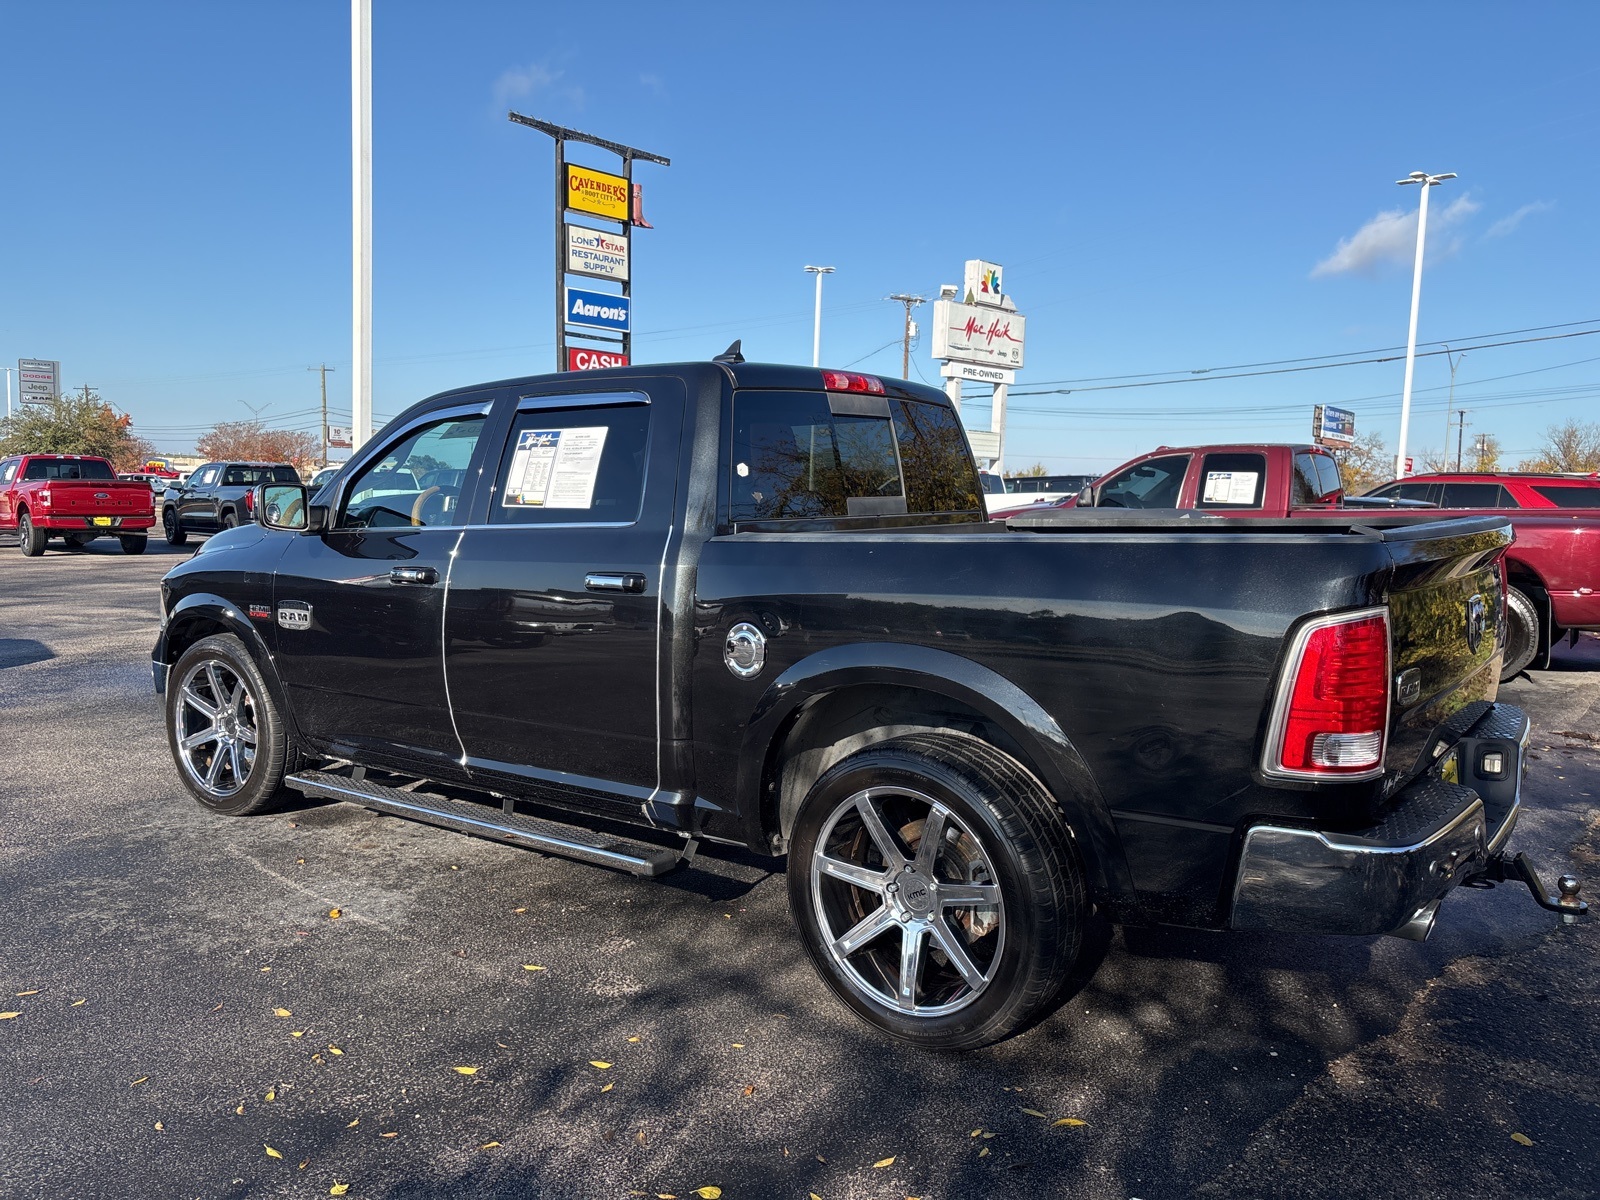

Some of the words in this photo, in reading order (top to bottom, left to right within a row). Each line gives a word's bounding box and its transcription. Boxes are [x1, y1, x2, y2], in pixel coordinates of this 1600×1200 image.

[569, 175, 627, 203] CAVENDER'S
[584, 189, 599, 199] BOOT
[600, 193, 615, 202] CITY
[571, 235, 595, 247] LONE
[604, 242, 625, 254] STAR
[571, 248, 626, 267] RESTAURANT
[583, 261, 615, 274] SUPPLY
[571, 298, 627, 322] Aaron's
[954, 316, 986, 342] Mac
[986, 318, 1018, 346] Haik
[576, 352, 623, 370] CASH
[962, 367, 1004, 380] PRE-OWNED
[28, 383, 48, 392] Jeep
[280, 611, 308, 622] RAM
